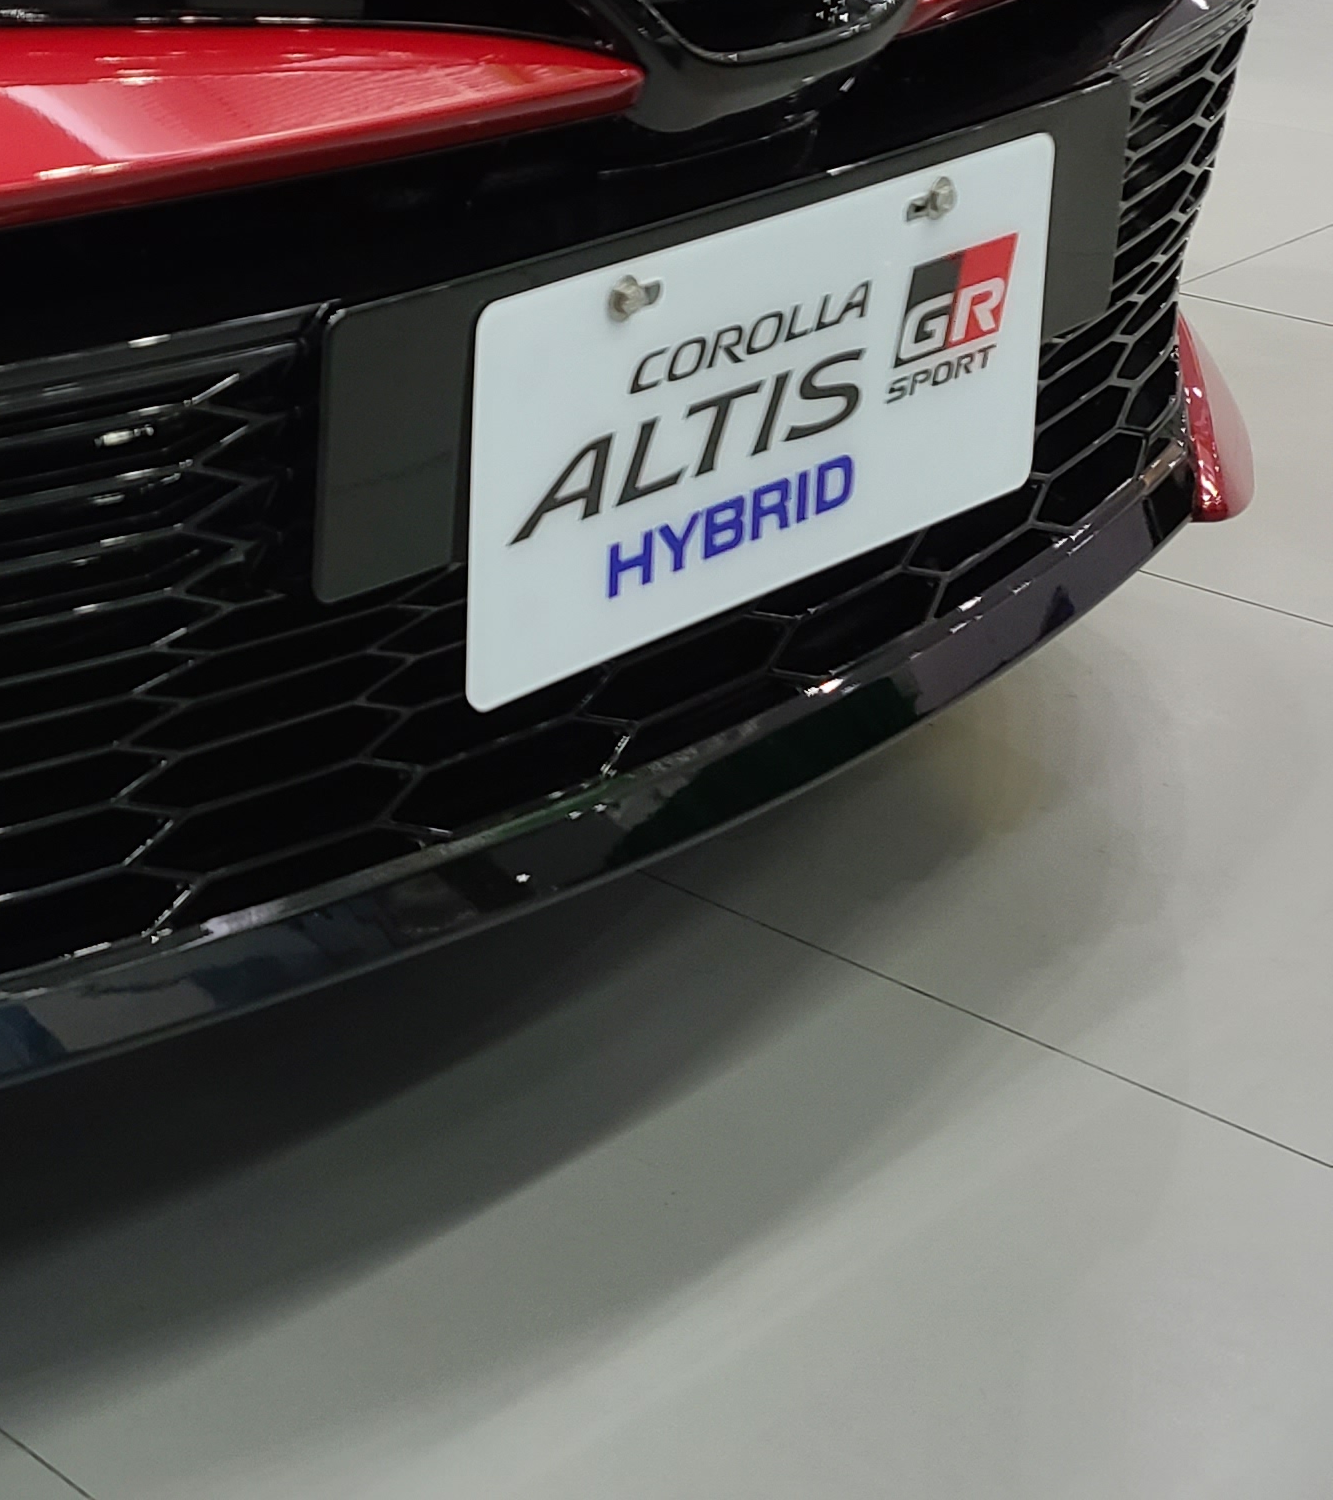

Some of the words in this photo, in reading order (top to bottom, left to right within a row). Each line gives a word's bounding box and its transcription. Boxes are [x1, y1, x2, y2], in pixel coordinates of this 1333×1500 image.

[628, 280, 873, 394] COROLLA
[885, 344, 997, 404] SPORT
[897, 272, 1009, 366] GR
[505, 347, 864, 547] ALTIS
[607, 453, 855, 600] HYBRID
